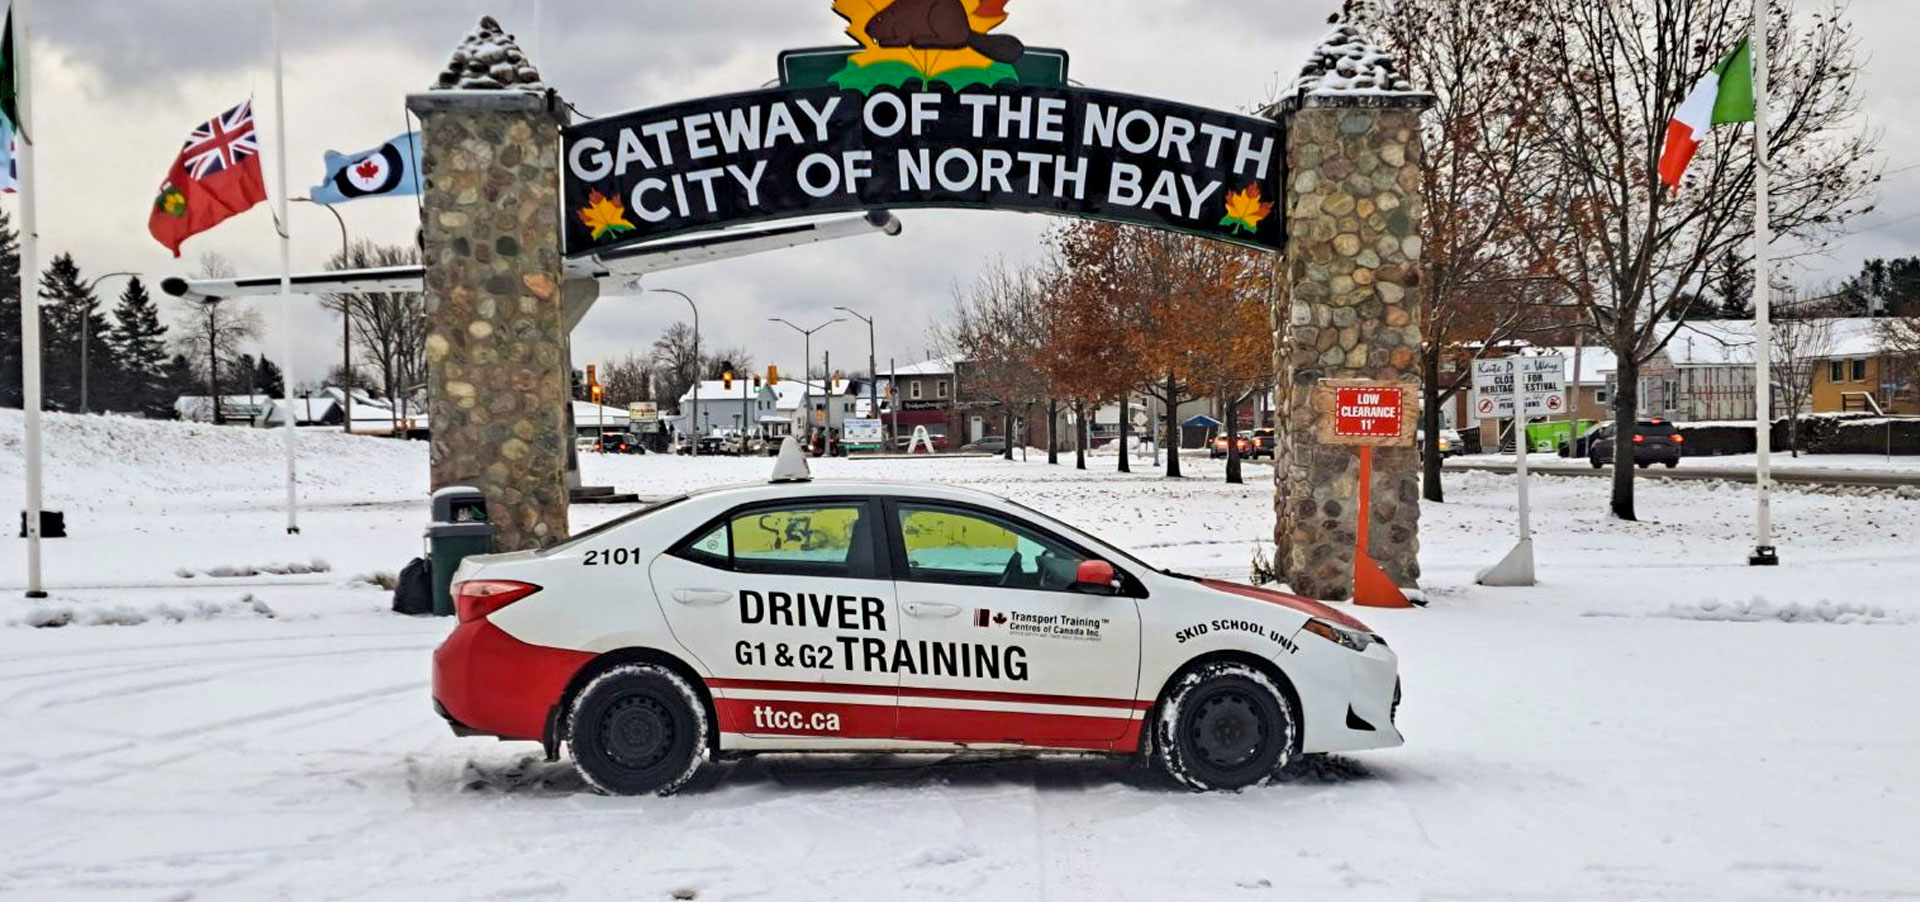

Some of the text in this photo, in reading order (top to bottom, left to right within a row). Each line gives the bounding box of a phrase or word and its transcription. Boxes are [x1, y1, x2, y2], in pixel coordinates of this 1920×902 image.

[568, 92, 1274, 182] GATEWAY OF THE NORTH
[631, 147, 1222, 222] CITY OF NORTH BAY
[1534, 359, 1558, 373] Way
[1527, 374, 1543, 382] FOR
[1480, 385, 1514, 393] HERITAG
[1357, 393, 1380, 405] LOW
[1341, 406, 1396, 418] CLEARANCE
[1360, 419, 1376, 431] 11'
[582, 547, 641, 566] 2101
[739, 589, 887, 632] DRIVER
[1011, 611, 1058, 625] Transport
[1009, 622, 1041, 633] Centres
[1043, 625, 1052, 633] of
[1053, 625, 1084, 636] Canada
[1175, 619, 1300, 655] SKID SCHOOL UNIT
[735, 640, 767, 666] G1
[774, 642, 794, 668] &
[798, 643, 834, 670] G2
[836, 635, 1029, 681] TRAINING
[753, 705, 841, 731] ttcc.ca
